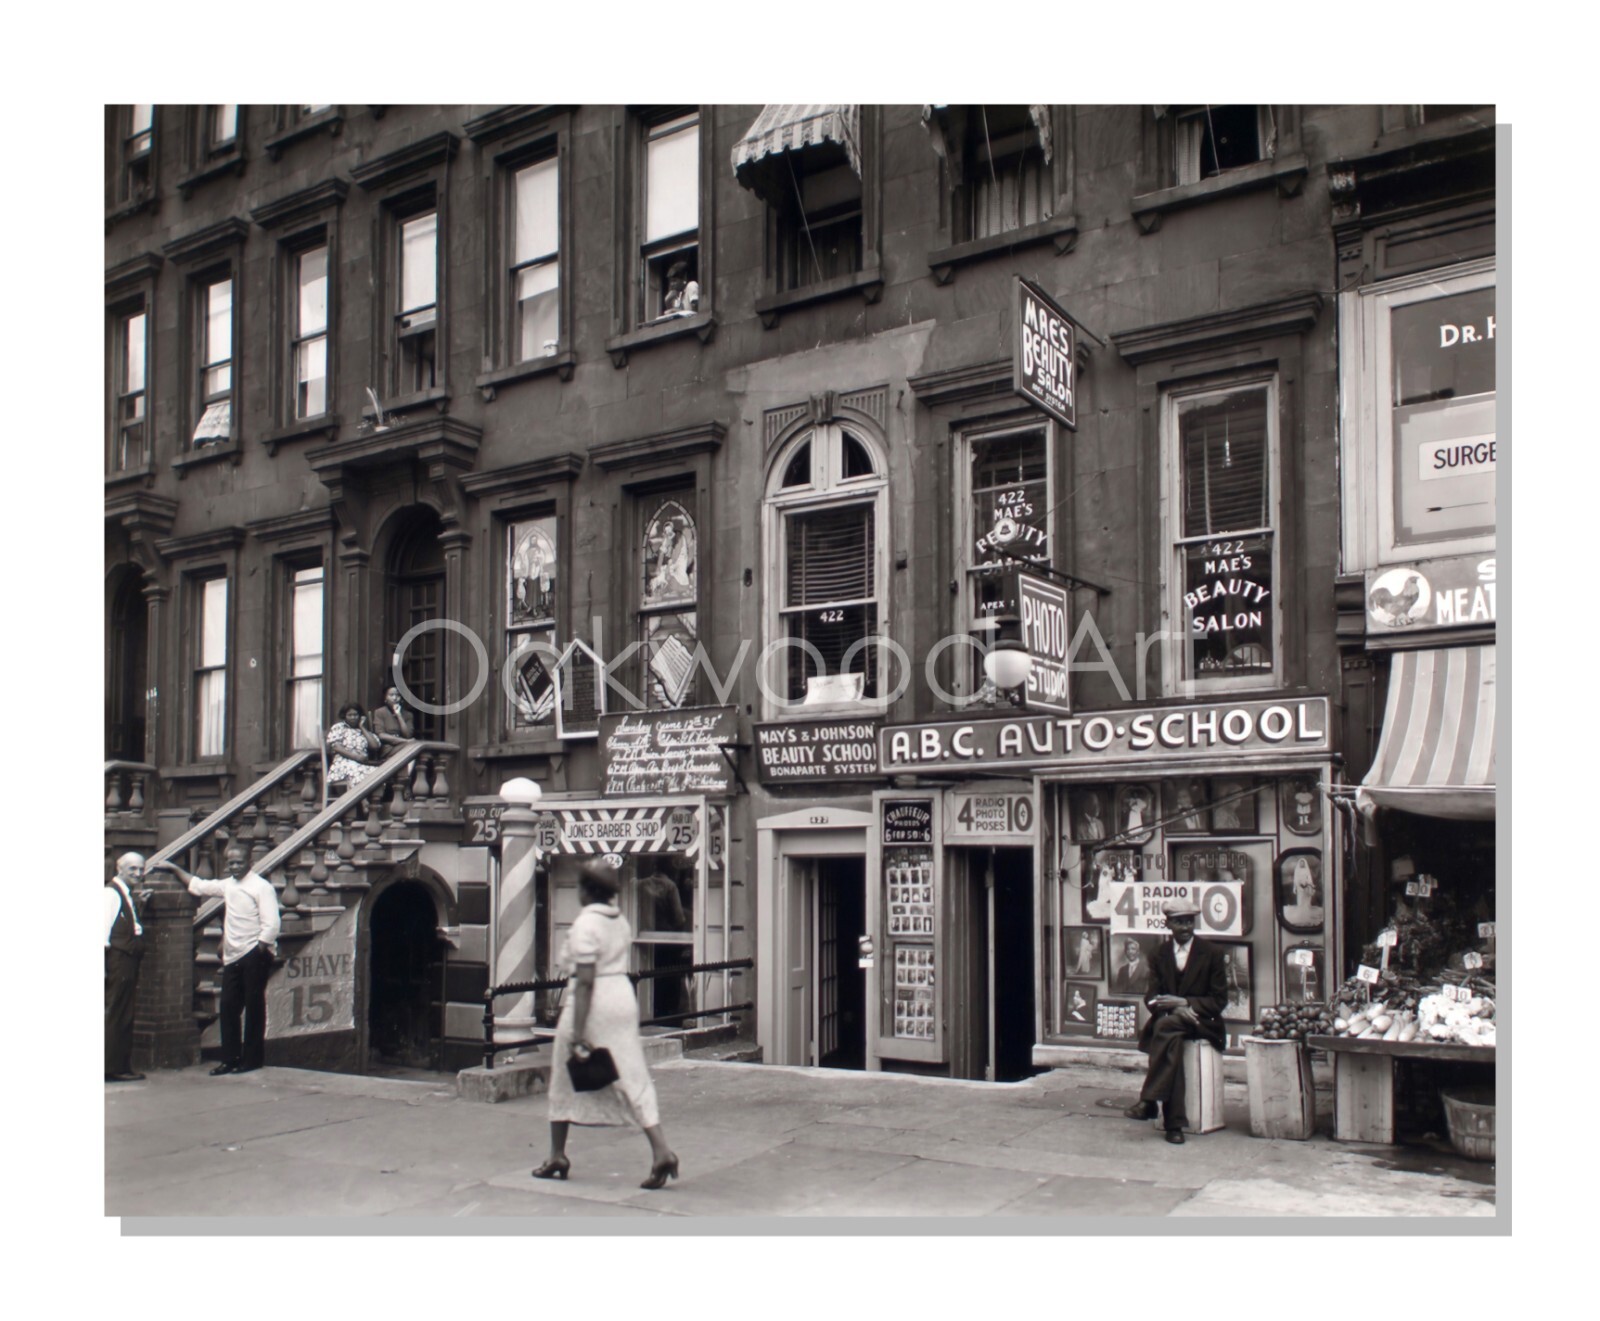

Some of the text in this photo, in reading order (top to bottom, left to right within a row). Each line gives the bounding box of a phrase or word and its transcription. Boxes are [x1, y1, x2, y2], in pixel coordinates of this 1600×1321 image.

[1025, 297, 1069, 355] MAE'S
[1023, 323, 1073, 389] BEAUTY
[1037, 367, 1073, 407] SALON
[998, 490, 1025, 505] 422
[994, 503, 1033, 521] MAE'S
[976, 523, 1048, 554] BEUTY
[1212, 540, 1245, 556] 422
[1204, 554, 1252, 575] MAE'S
[1183, 578, 1270, 611] BEAUTY
[980, 599, 1004, 610] APEX
[819, 609, 845, 622] 422
[1192, 610, 1262, 633] SALON
[1022, 594, 1065, 659] PHOTO
[1027, 665, 1067, 699] STUDIO
[759, 726, 798, 744] MAY'S
[801, 731, 810, 742] &
[891, 726, 985, 762] A.B.C.
[762, 745, 816, 765] BEAUTY
[770, 765, 827, 777] BONAPARTE
[976, 798, 1006, 808] RADIO
[468, 807, 487, 819] HAIR
[886, 806, 931, 824] CHAUFFEUR
[957, 797, 976, 832] 4
[976, 809, 1006, 819] PHOTO
[567, 821, 659, 839] JONES BARBER SHOP
[976, 820, 1006, 832] POSES
[1109, 851, 1248, 870] PHOTO STUDIO
[1143, 886, 1188, 898] RADIO
[1114, 886, 1139, 929] 4
[1147, 918, 1167, 929] POS
[286, 953, 351, 979] SHAVE
